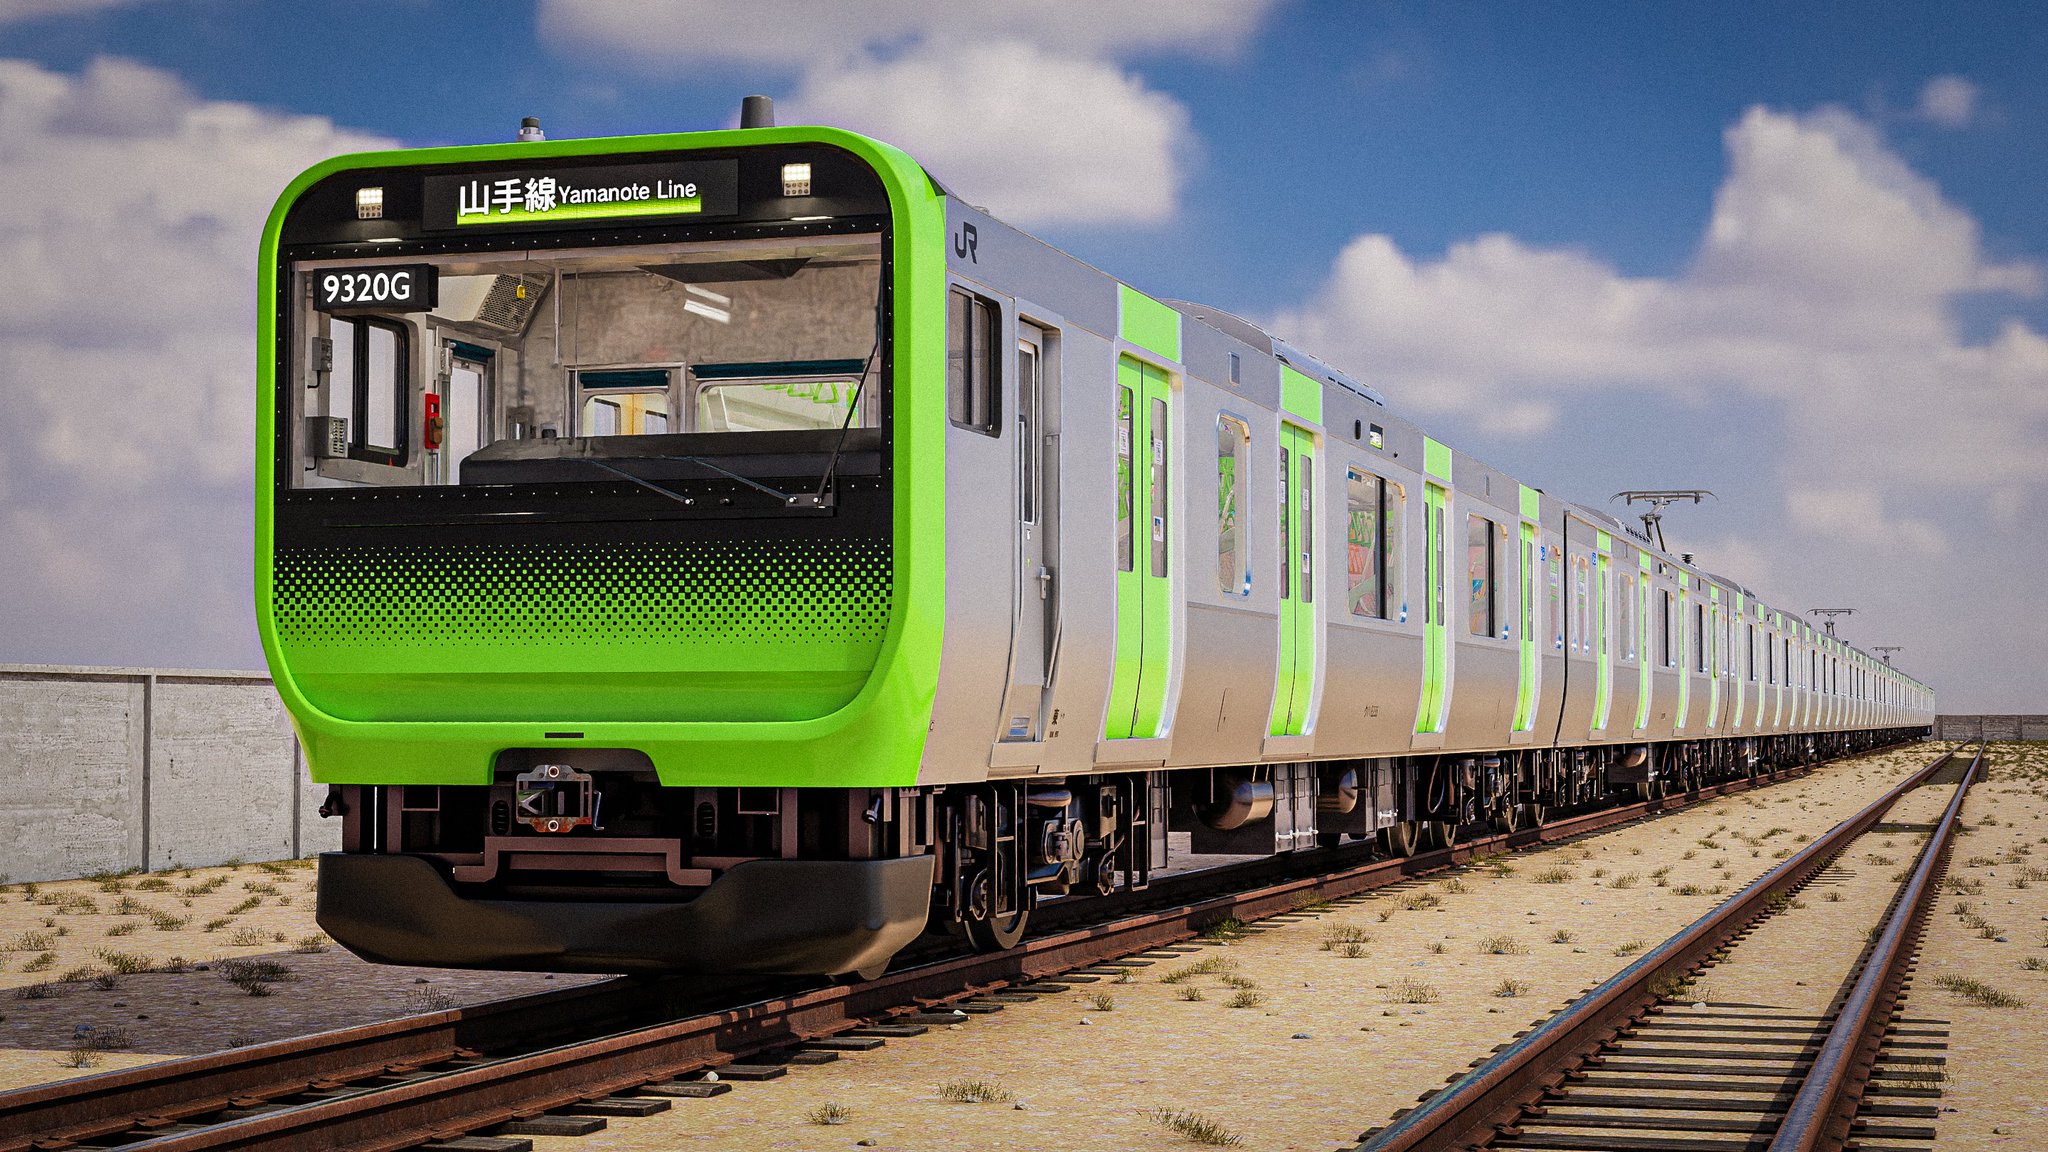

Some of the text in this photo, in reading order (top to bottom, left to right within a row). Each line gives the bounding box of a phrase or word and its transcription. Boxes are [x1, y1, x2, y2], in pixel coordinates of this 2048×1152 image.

[459, 176, 697, 216] 山手線 Yamanote Line
[954, 221, 978, 265] JR
[323, 271, 410, 303] 9320G
